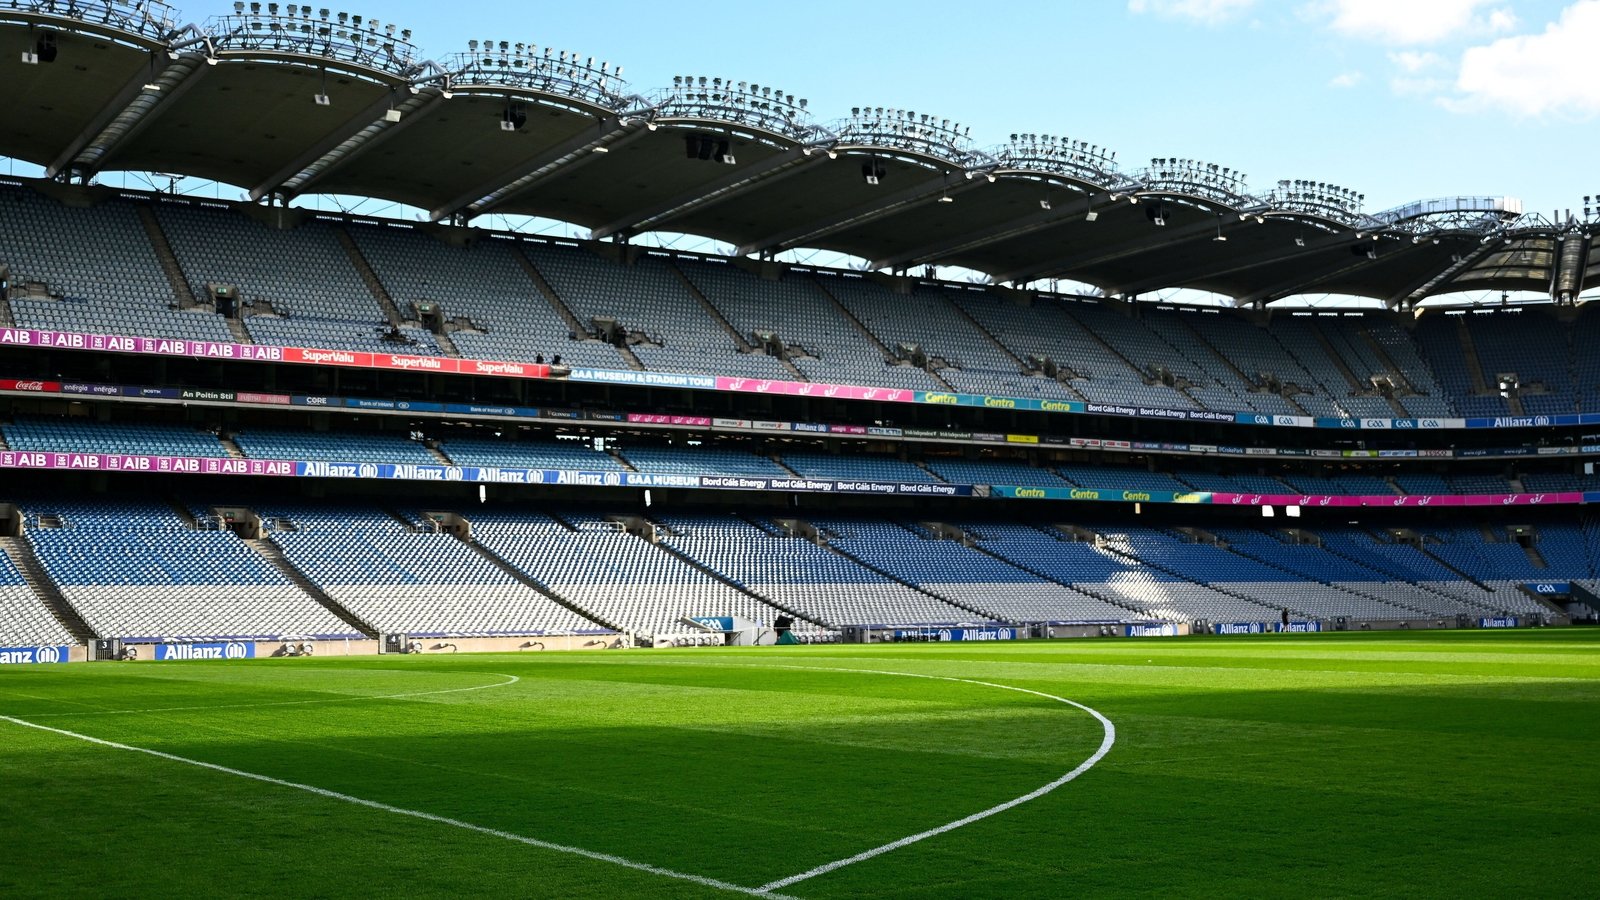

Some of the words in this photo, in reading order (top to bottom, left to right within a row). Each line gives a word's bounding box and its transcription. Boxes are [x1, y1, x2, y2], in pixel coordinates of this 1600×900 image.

[2, 330, 30, 343] AIB
[56, 334, 83, 346] AIB
[108, 338, 134, 350] AIB
[160, 341, 184, 353] AIB
[208, 344, 233, 356] AIB
[256, 348, 280, 360] AIB
[302, 350, 354, 364] SuperValu
[392, 356, 440, 368] SuperValu
[476, 362, 523, 374] SuperValu
[571, 370, 594, 379] GAA
[594, 372, 635, 382] MUSEUM
[646, 375, 688, 385] STADIUM
[690, 378, 714, 386] TOUR
[730, 378, 745, 390] eir
[757, 380, 771, 392] eir
[799, 383, 813, 395] eir
[824, 384, 838, 396] eir
[864, 388, 877, 399] eir
[888, 389, 900, 400] eir
[925, 392, 957, 404] Centra
[984, 397, 1014, 408] Centra
[1041, 400, 1070, 411] Centra
[1116, 406, 1136, 415] Energy
[795, 424, 817, 432] Allianz
[1494, 417, 1532, 428] Allianz
[18, 454, 46, 466] AIB
[72, 456, 99, 467] AIB
[124, 457, 150, 470] AIB
[174, 459, 199, 471] AIB
[222, 461, 247, 472] AIB
[267, 462, 291, 474] AIB
[304, 462, 356, 477] Allianz
[393, 464, 442, 480] Allianz
[478, 468, 524, 482] Allianz
[557, 470, 602, 484] Allianz
[628, 475, 651, 484] GAA
[653, 476, 699, 486] MUSEUM
[722, 478, 738, 486] Gáis
[740, 480, 766, 488] Energy
[791, 480, 806, 488] Gáis
[807, 482, 832, 491] Energy
[872, 484, 895, 492] Energy
[933, 486, 955, 494] Energy
[1015, 487, 1045, 498] Centra
[1070, 489, 1098, 499] Centra
[1123, 491, 1150, 501] Centra
[1232, 494, 1243, 504] eir
[1251, 495, 1261, 505] eir
[1300, 496, 1310, 505] eir
[1320, 496, 1331, 506] eir
[1394, 496, 1407, 506] eir
[1418, 496, 1431, 506] eir
[1503, 495, 1518, 504] eir
[1530, 494, 1545, 504] eir
[1483, 618, 1505, 627] Allianz
[962, 629, 996, 640] Allianz
[1130, 626, 1161, 636] Allianz
[1220, 624, 1248, 634] Allianz
[164, 644, 222, 659] Allianz
[0, 651, 32, 664] anz
